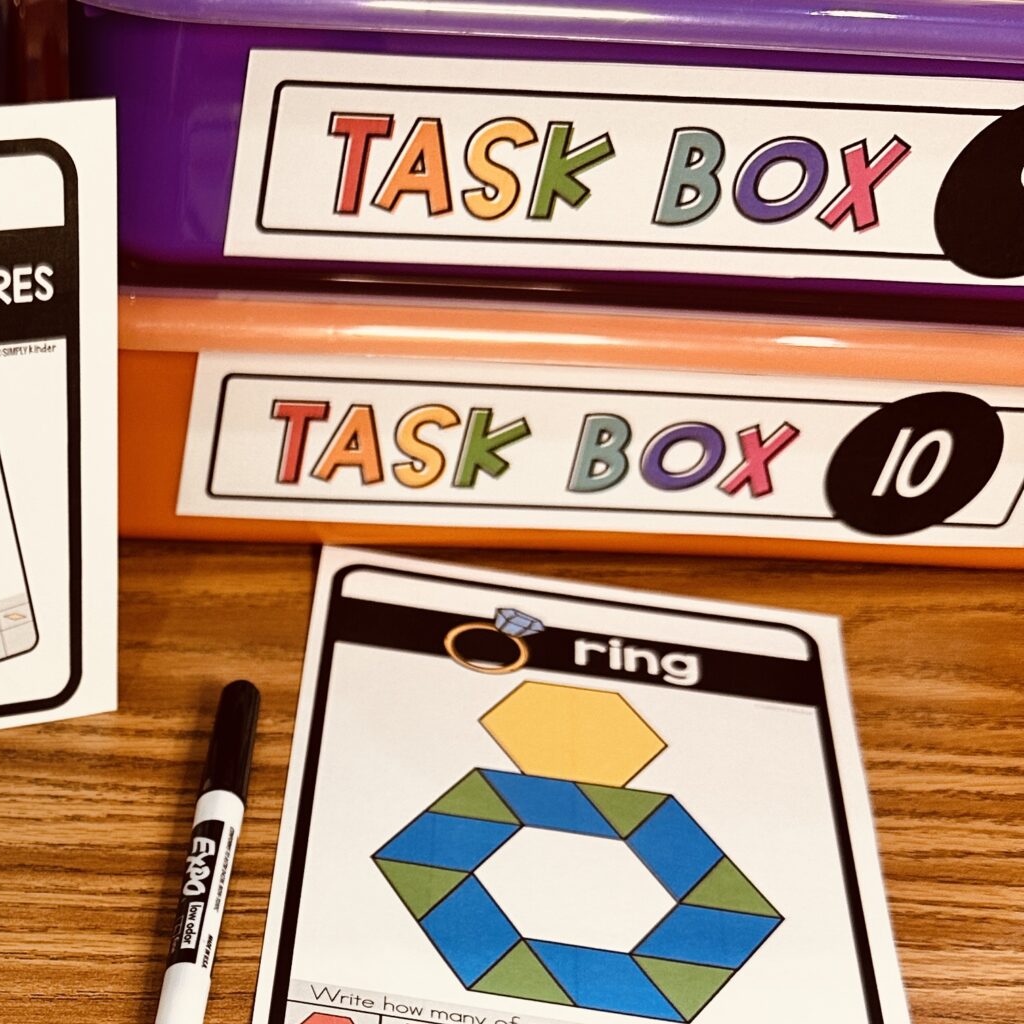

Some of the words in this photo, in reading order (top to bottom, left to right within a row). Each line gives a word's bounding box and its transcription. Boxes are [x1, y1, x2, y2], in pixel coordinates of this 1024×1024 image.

[329, 111, 615, 221] TASK
[652, 127, 911, 232] BOX
[270, 398, 531, 489] TASK
[566, 413, 800, 499] BOX
[870, 426, 955, 499] 10
[574, 638, 703, 687] ring
[188, 904, 202, 920] low
[184, 922, 197, 944] odor
[310, 984, 374, 1009] Write
[383, 996, 423, 1016] how
